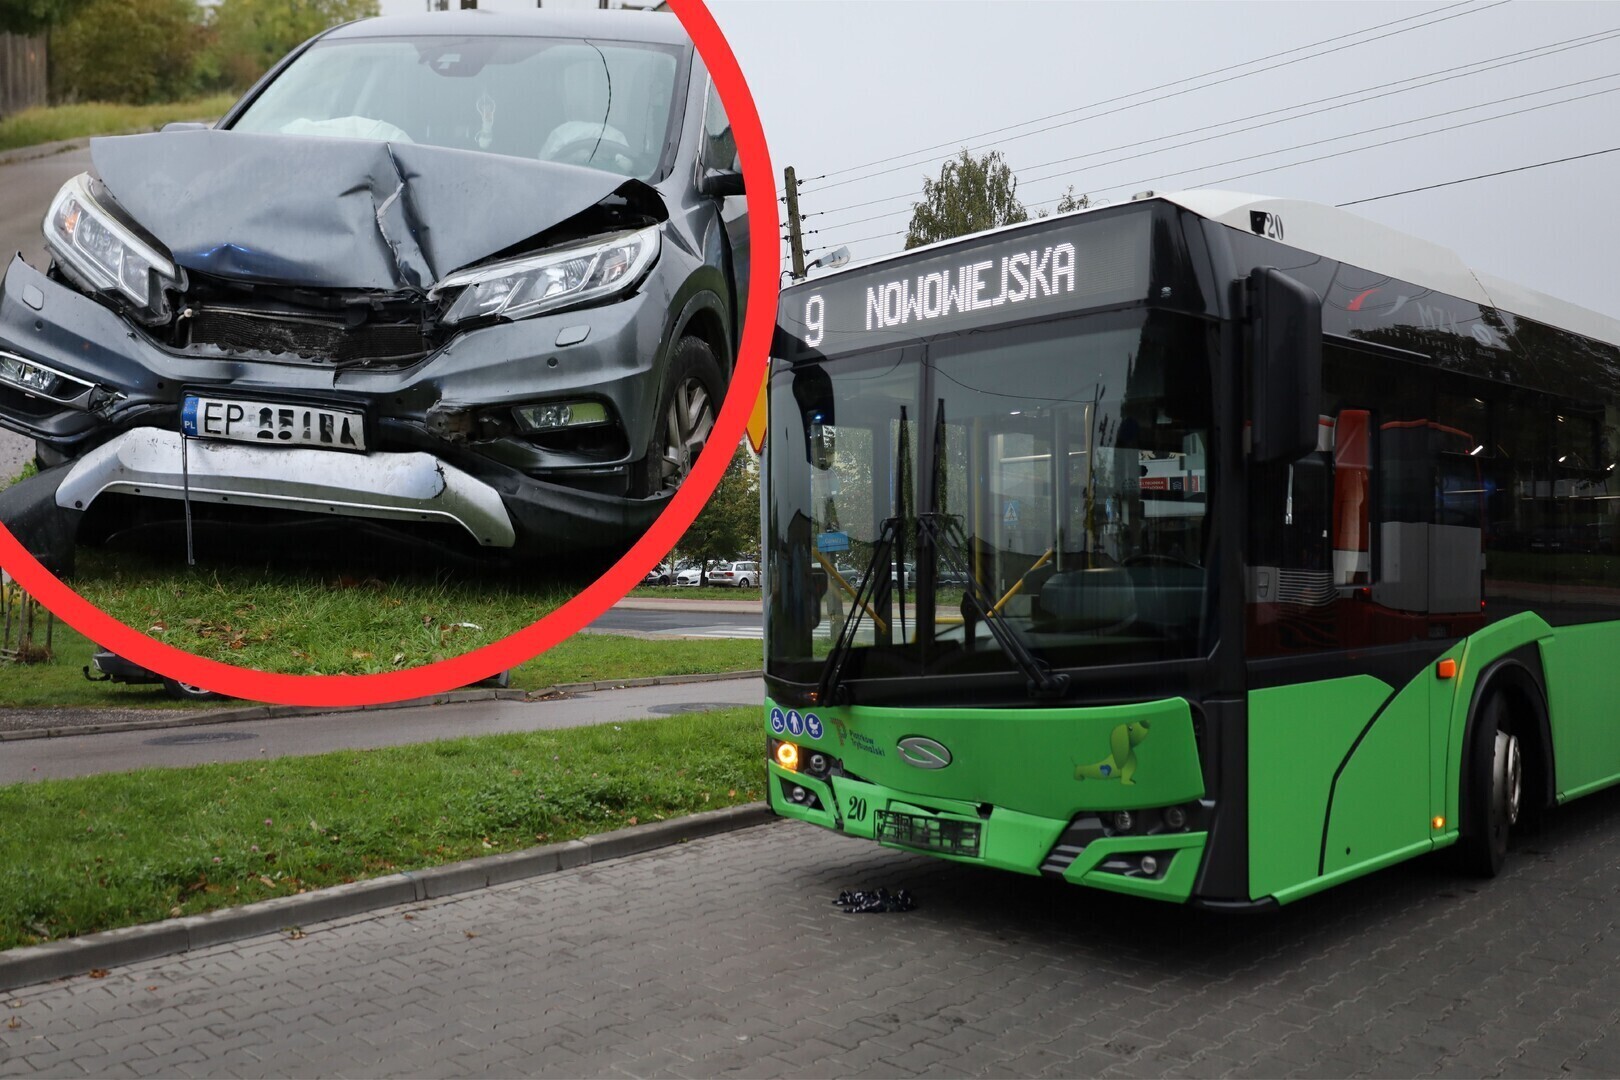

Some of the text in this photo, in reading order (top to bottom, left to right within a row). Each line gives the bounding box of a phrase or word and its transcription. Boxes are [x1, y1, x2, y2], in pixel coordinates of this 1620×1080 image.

[1265, 212, 1284, 241] 20
[805, 242, 1076, 348] 9 NOWOWIEJSKA
[1416, 301, 1466, 337] MZK
[184, 420, 196, 430] PL
[847, 795, 868, 823] 20
